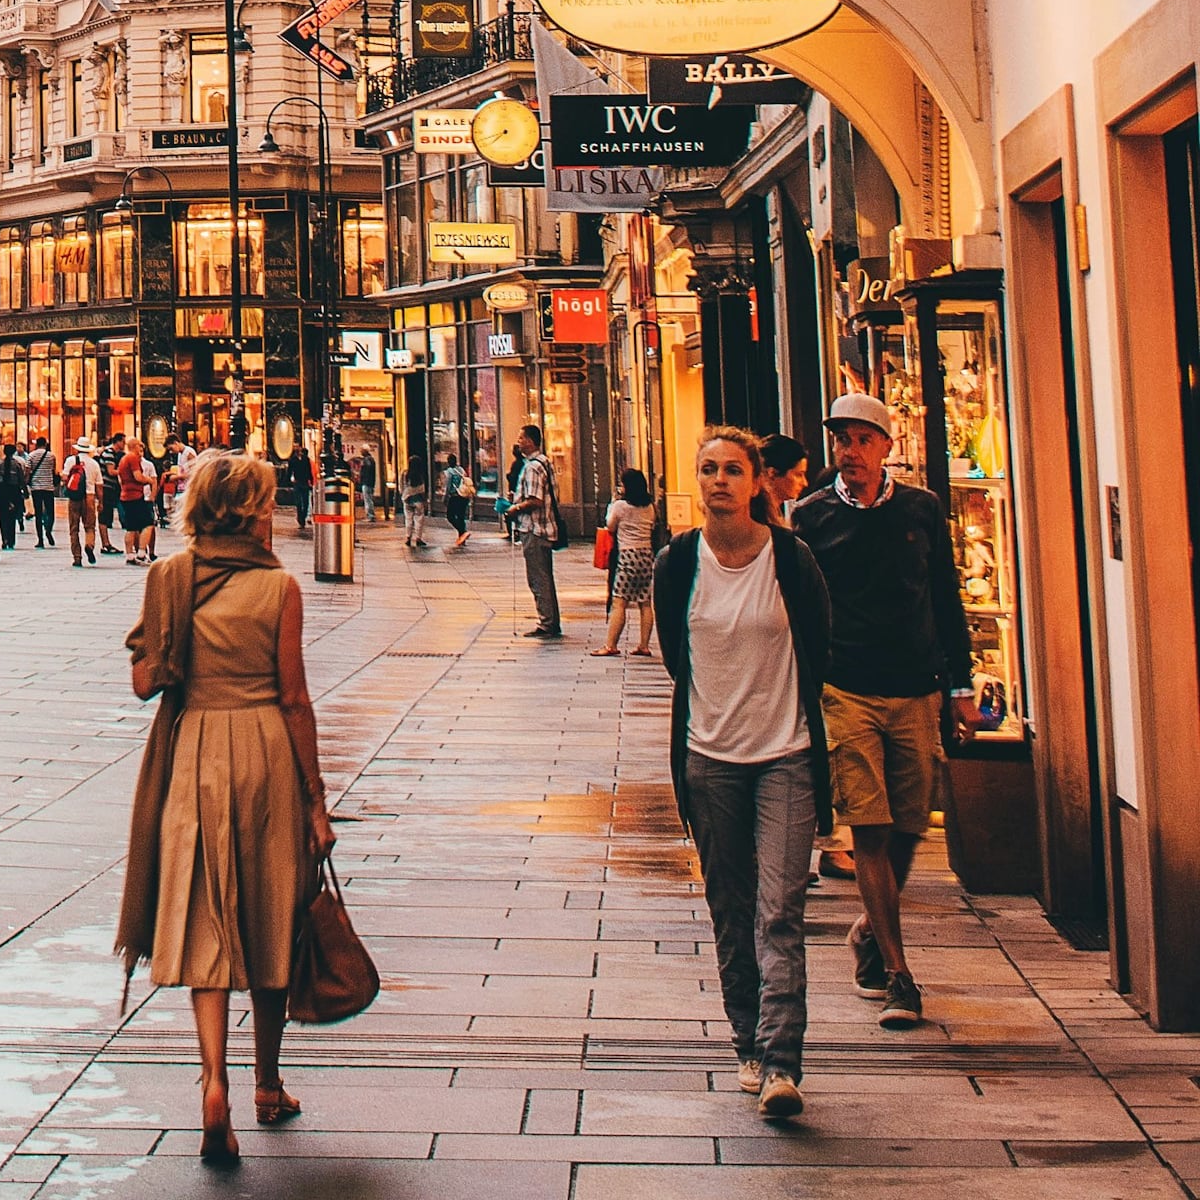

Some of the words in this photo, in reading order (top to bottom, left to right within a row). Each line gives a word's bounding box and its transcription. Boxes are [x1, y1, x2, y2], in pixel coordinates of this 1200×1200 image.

[685, 63, 777, 83] BALLY
[603, 105, 677, 134] IWC
[173, 133, 206, 145] BRAUN
[580, 141, 705, 154] SCHAFFHAUSEN
[553, 168, 657, 195] LISKA
[488, 333, 515, 355] FOSSIL
